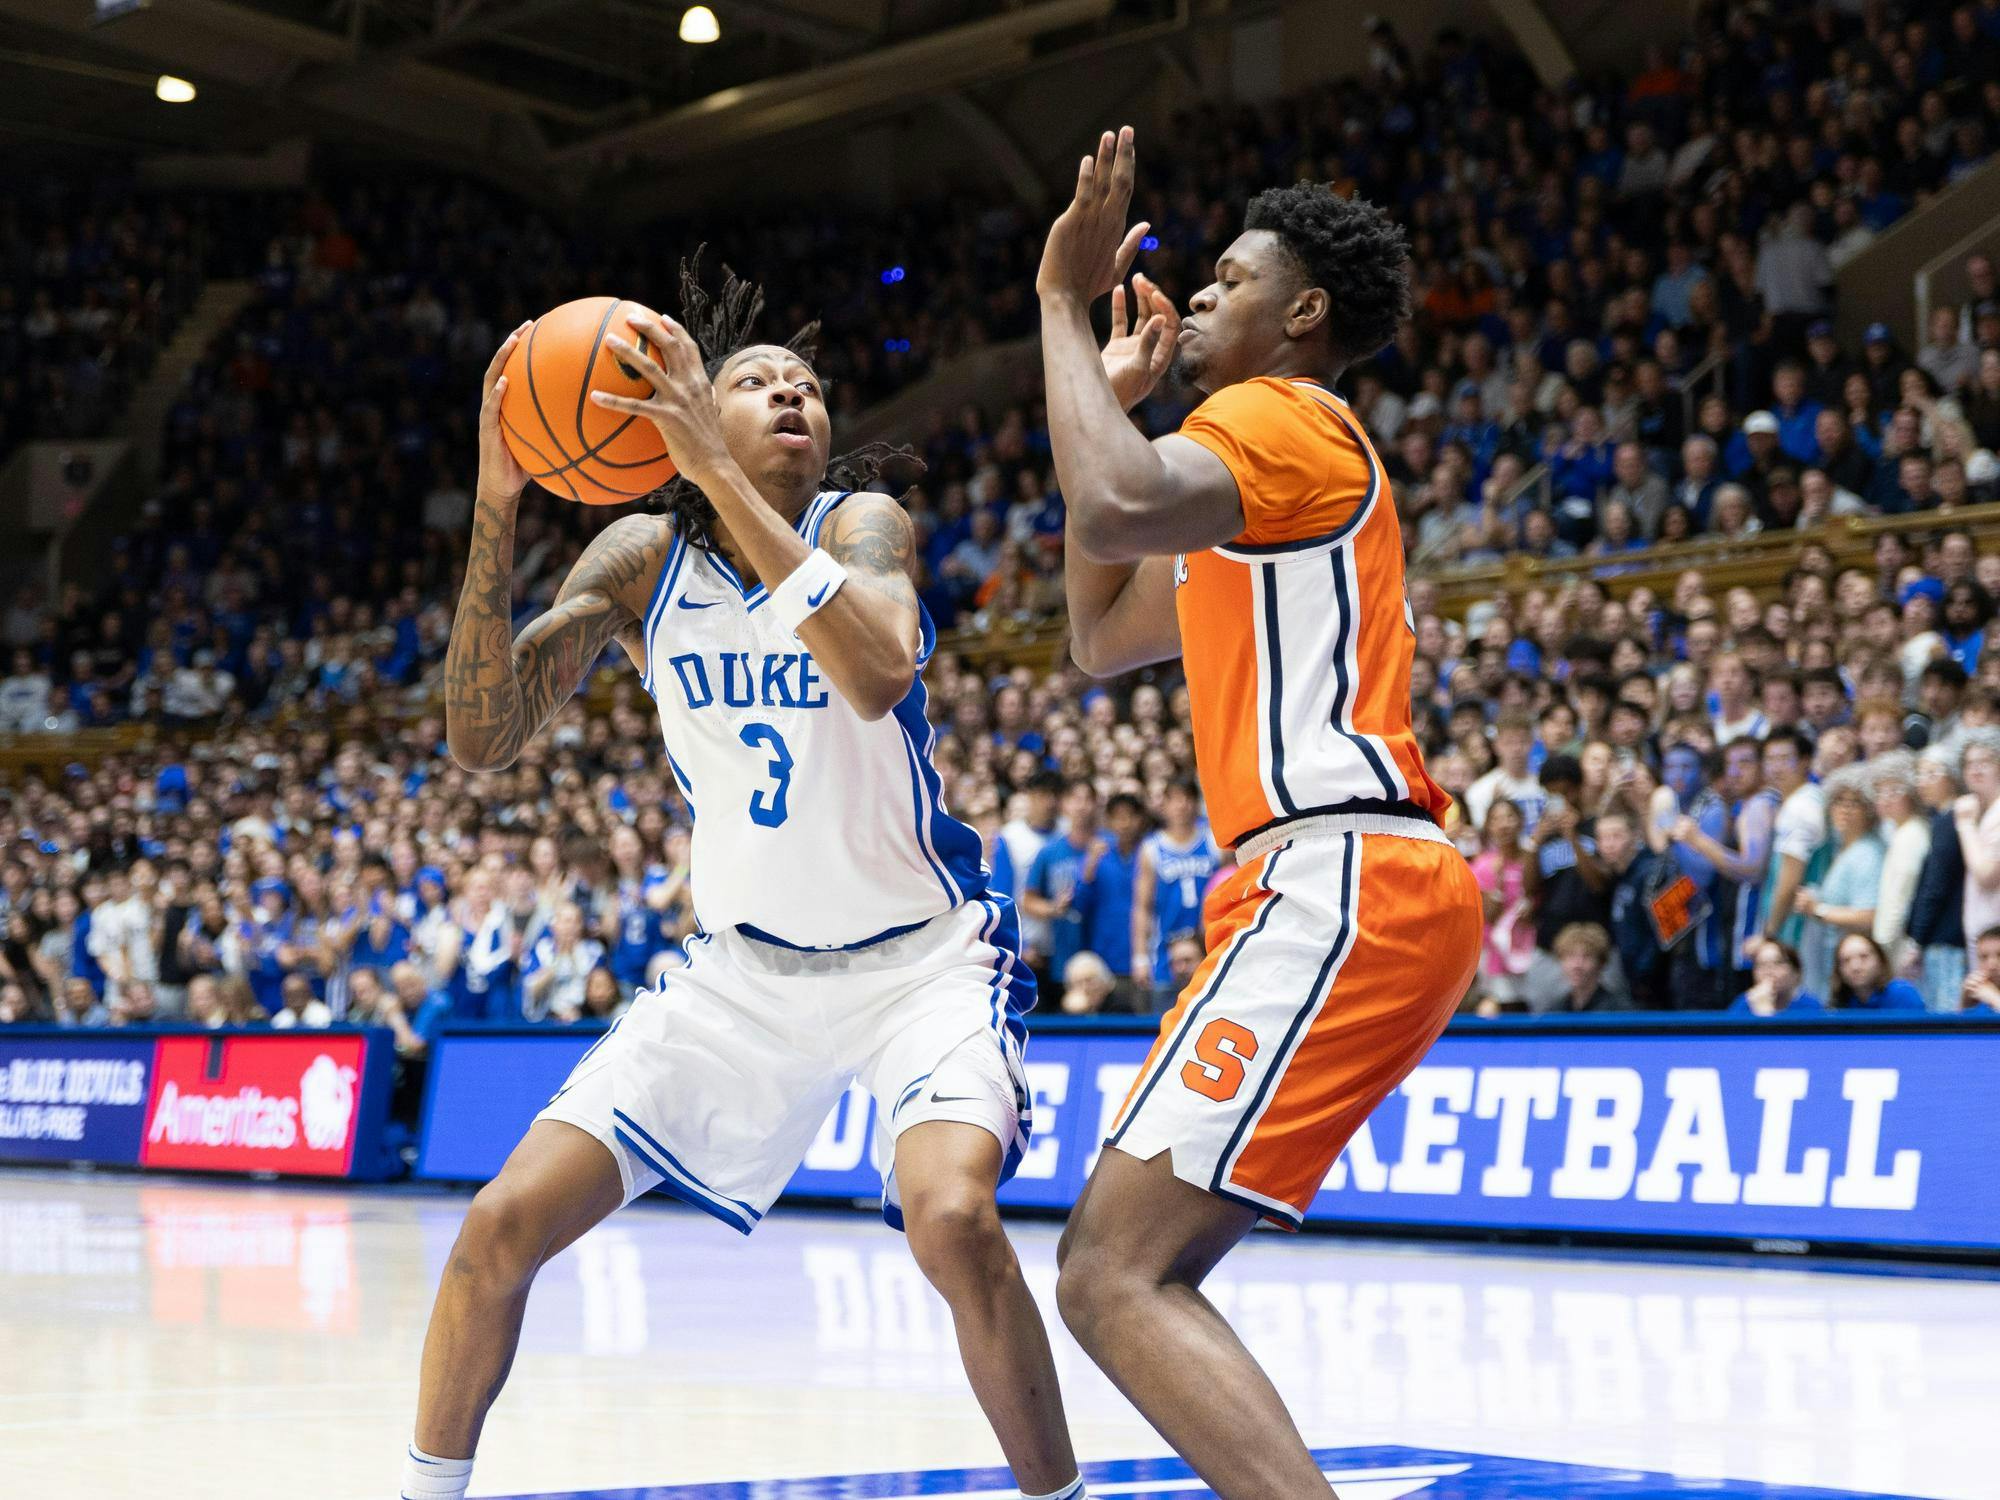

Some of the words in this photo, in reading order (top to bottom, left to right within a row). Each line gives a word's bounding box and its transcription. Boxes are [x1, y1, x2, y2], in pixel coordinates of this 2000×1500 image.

[669, 652, 829, 710] DUKE
[739, 722, 794, 829] 3
[1180, 1017, 1259, 1103] S
[150, 1080, 297, 1149] Ameritas
